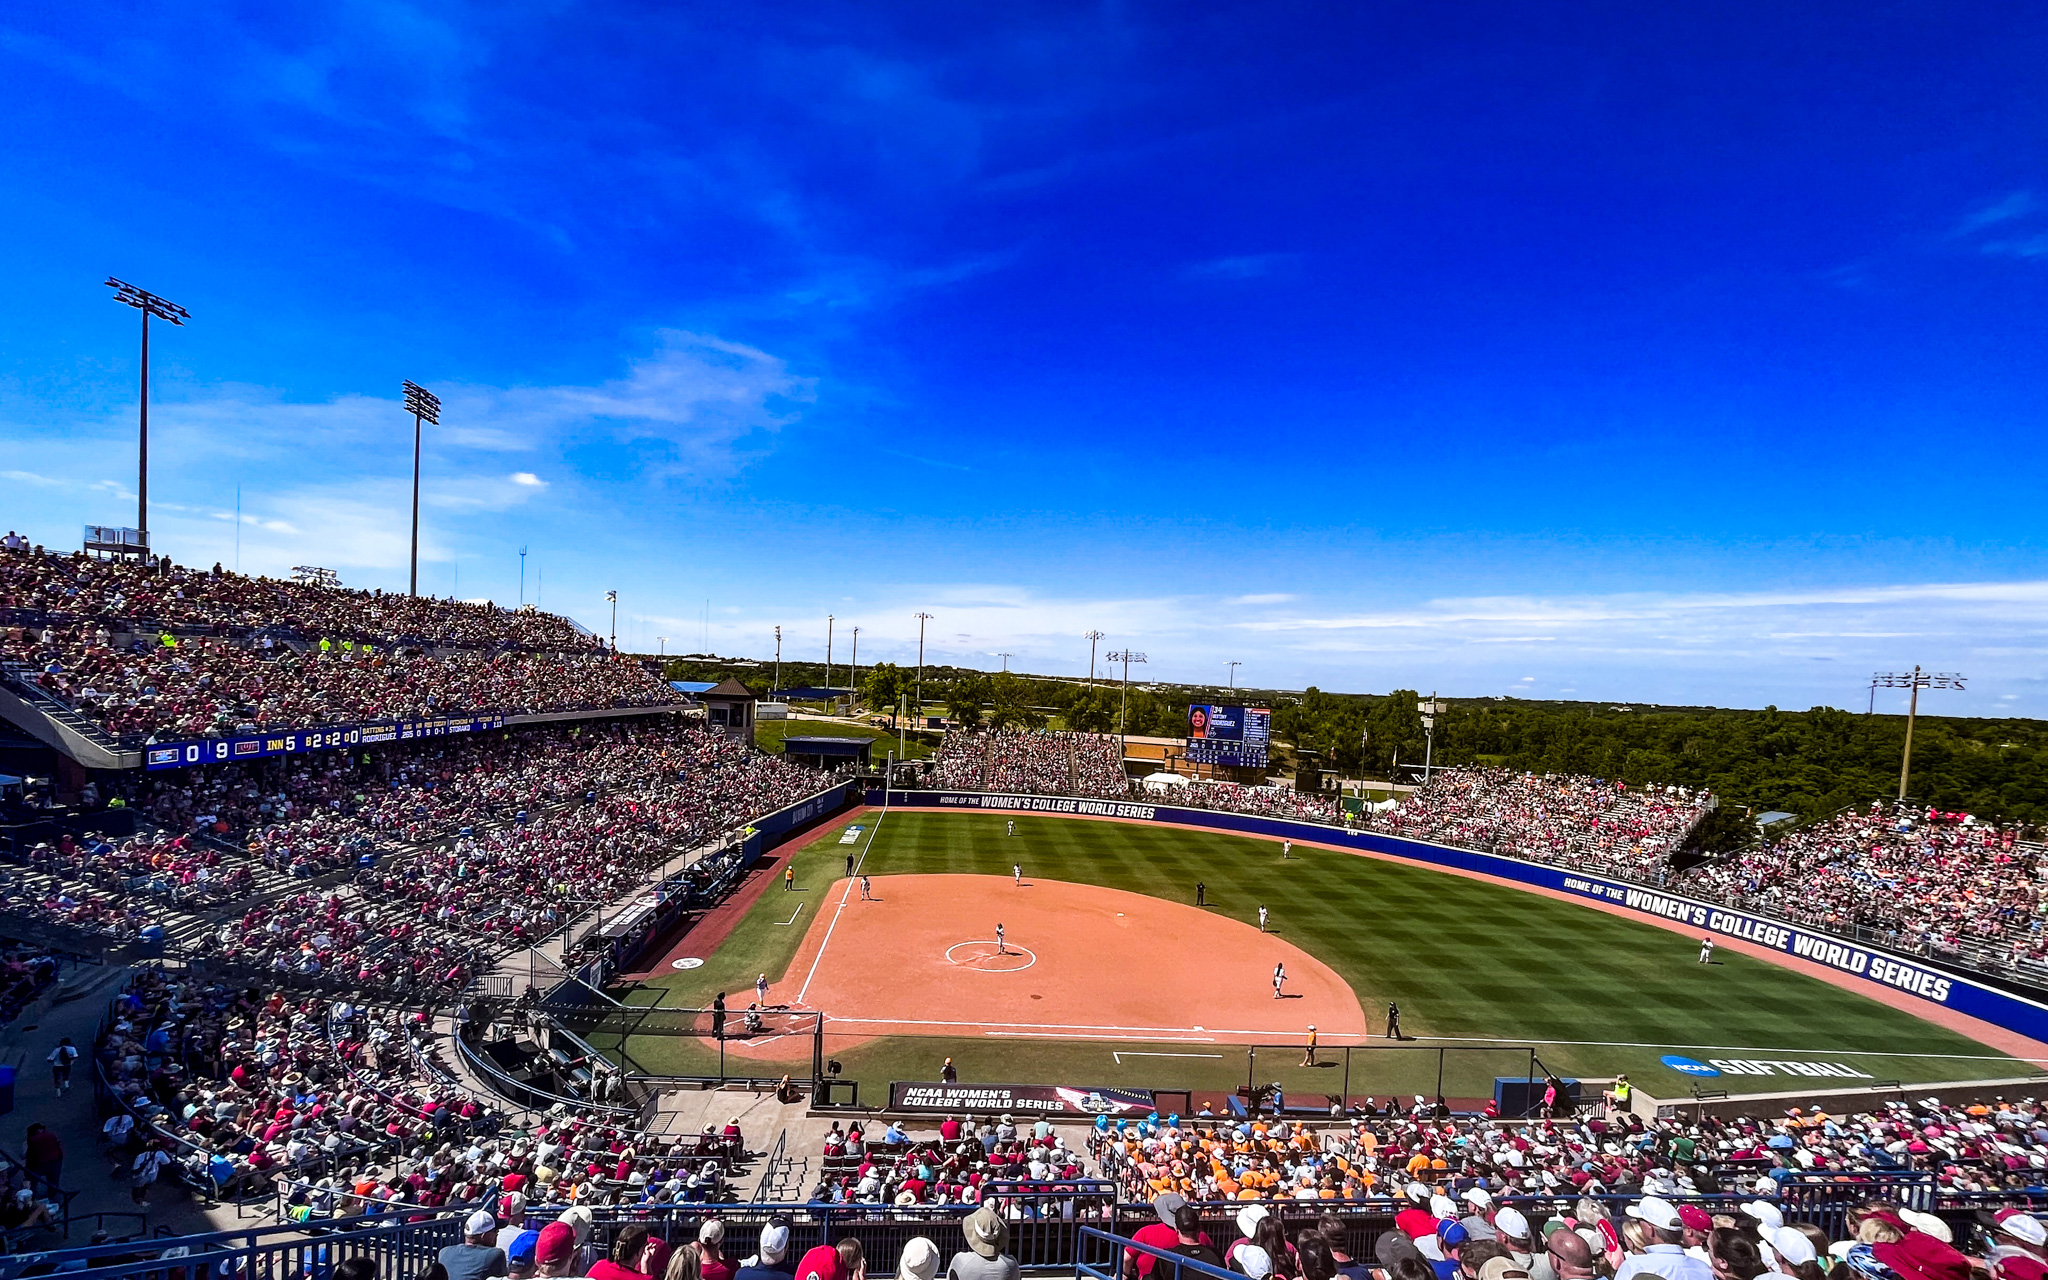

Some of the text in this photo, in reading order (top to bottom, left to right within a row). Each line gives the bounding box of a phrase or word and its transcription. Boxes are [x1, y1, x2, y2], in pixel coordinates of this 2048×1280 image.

[362, 726, 385, 735] BATTING
[362, 732, 397, 744] RODRIGUEZ
[266, 739, 284, 751] INN
[285, 736, 296, 751] 5
[305, 733, 322, 748] B 2
[325, 731, 341, 746] S 2
[186, 745, 199, 762] 0
[216, 742, 228, 758] 9
[940, 796, 958, 804] HOME
[968, 797, 980, 805] THE
[980, 795, 1030, 810] WOMEN'S
[1032, 798, 1077, 813] COLLEGE
[1077, 802, 1116, 816] WORLD
[1116, 804, 1156, 819] SERIES
[1563, 877, 1950, 1002] HOME OF THE WOMEN'S COLLEGE WORLD SERIES
[1708, 1059, 1875, 1079] SOFTBALL
[906, 1087, 1012, 1099] NCAA WOMEN'S
[902, 1097, 1065, 1112] COLLEGE WORLD SERIES
